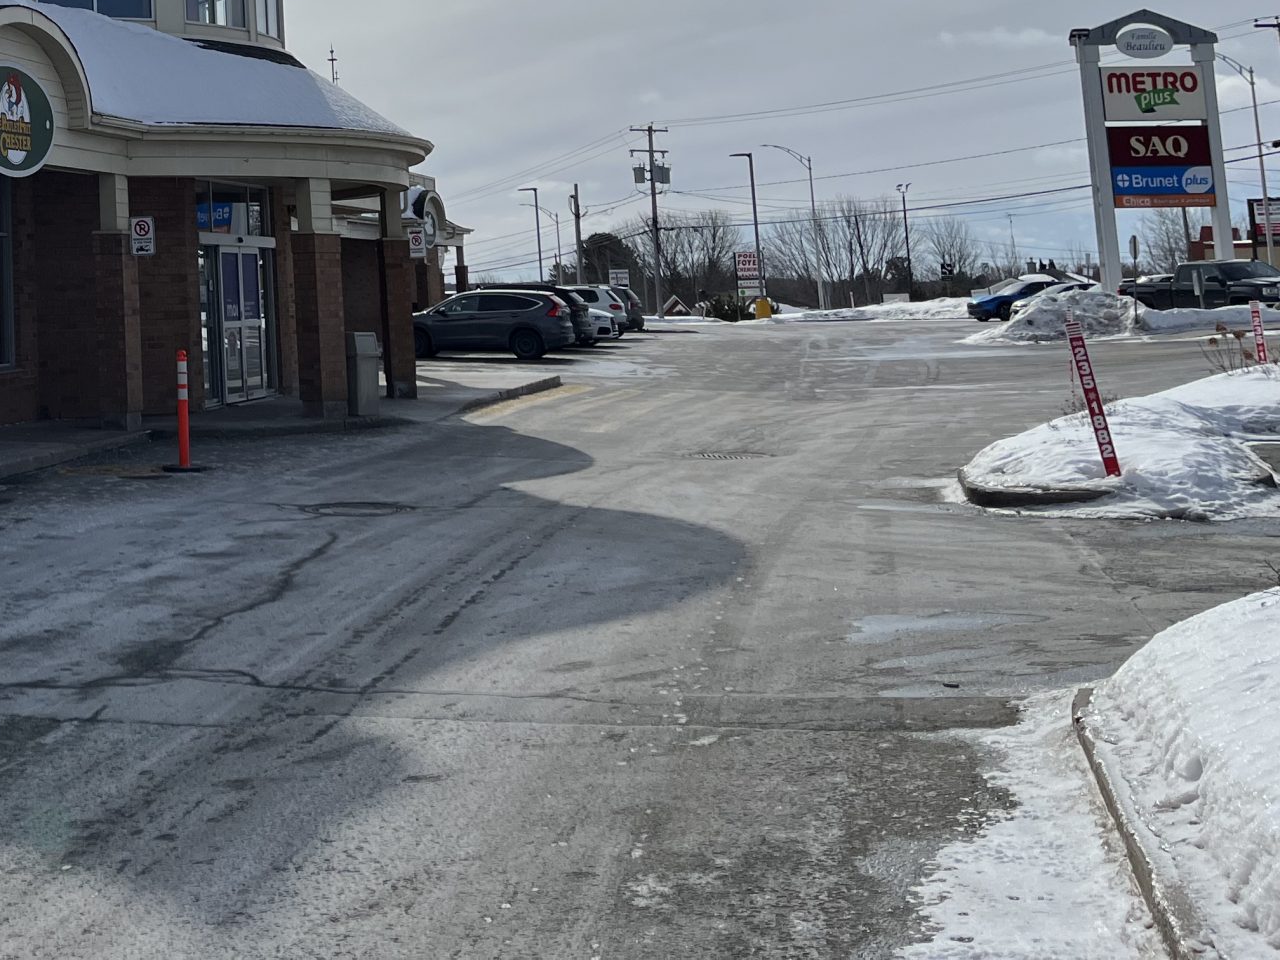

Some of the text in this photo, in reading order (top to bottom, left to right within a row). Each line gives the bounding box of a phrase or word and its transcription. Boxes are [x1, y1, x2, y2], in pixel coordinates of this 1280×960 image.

[1126, 41, 1166, 52] Beaulieu
[1107, 71, 1198, 94] METRO
[0, 132, 32, 157] CHESTER
[1129, 135, 1189, 158] SAQ
[1131, 174, 1208, 188] Brunet plus
